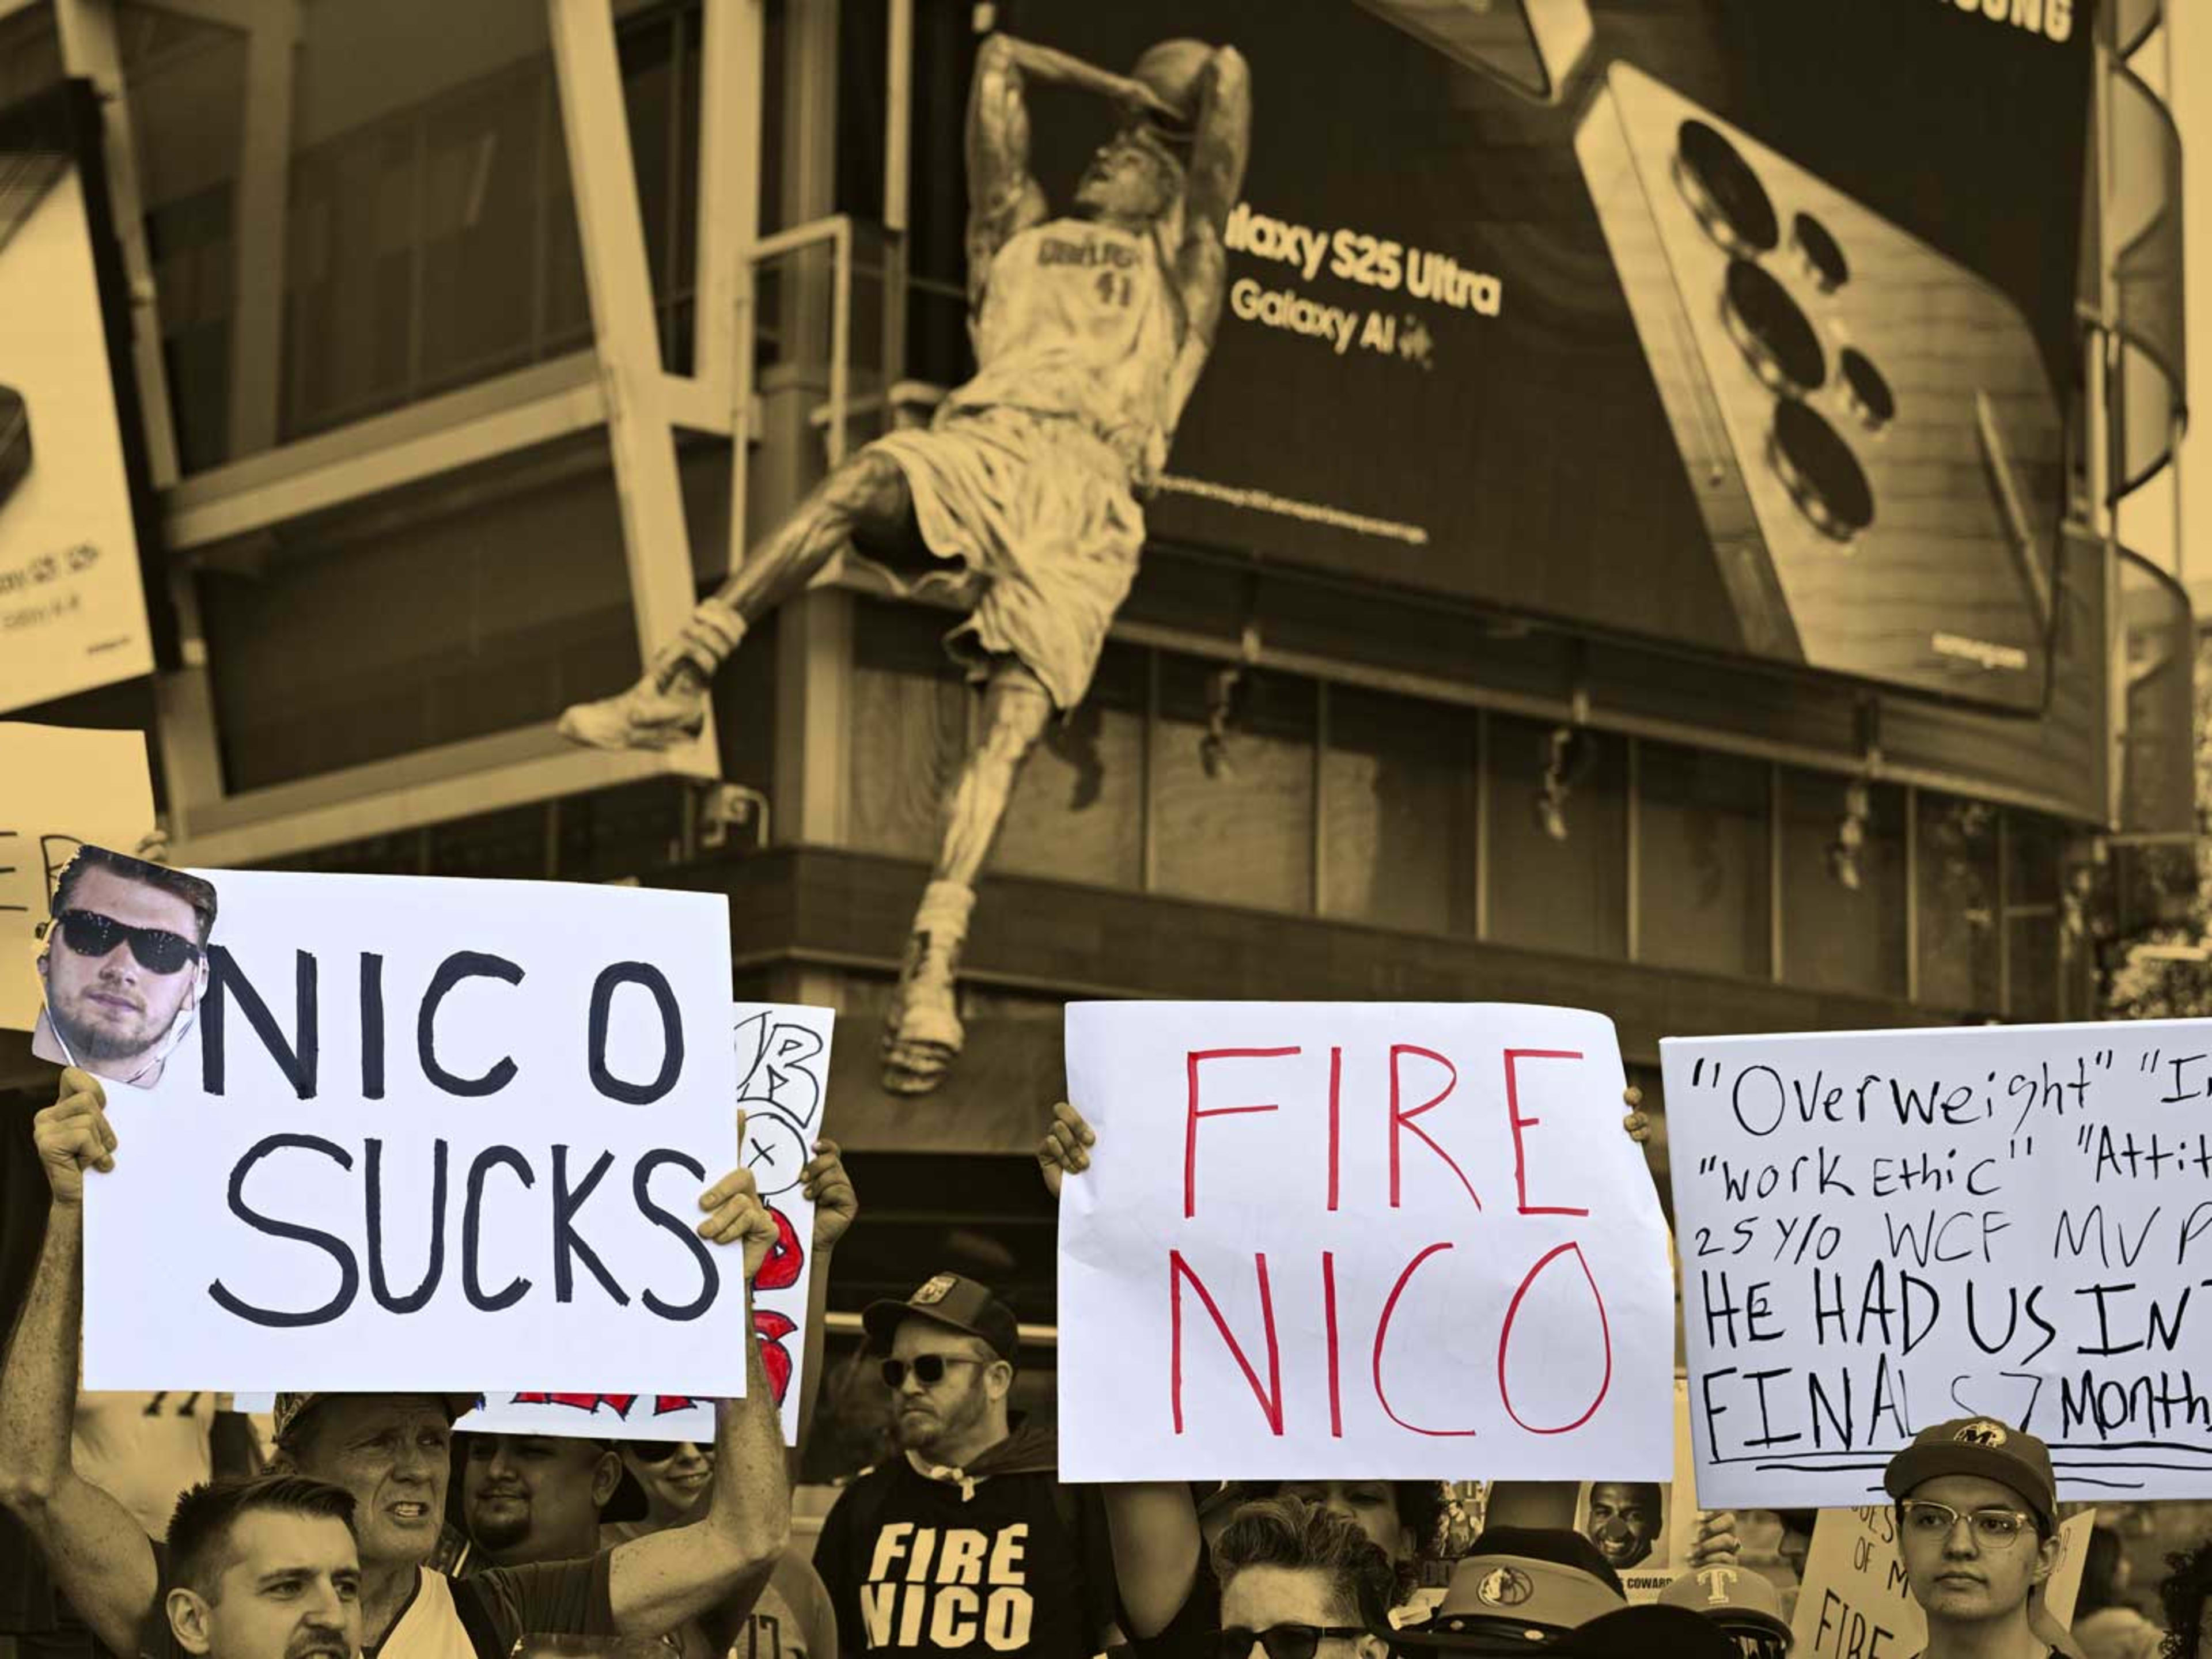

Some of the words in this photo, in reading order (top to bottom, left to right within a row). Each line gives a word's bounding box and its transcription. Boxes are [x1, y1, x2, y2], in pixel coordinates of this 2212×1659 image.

[1225, 202, 1328, 281] laxy
[1330, 228, 1402, 291] S25
[1406, 248, 1501, 317] Ultra
[1230, 278, 1358, 355] Galaxy
[199, 943, 684, 1105] NICO
[1184, 1044, 1589, 1219] FIRE
[208, 1132, 719, 1327] SUCKS
[1884, 1209, 2011, 1268] WCF
[1170, 1241, 1611, 1438] NICO
[1701, 1269, 1786, 1349] HE
[1813, 1259, 1940, 1357] HAD
[1966, 1278, 2056, 1366] US
[2074, 1282, 2191, 1356] IN
[2061, 1369, 2212, 1440] Month
[868, 1522, 1029, 1586] FIRE
[1697, 1567, 1738, 1605] T
[1854, 1536, 1875, 1574] OF
[860, 1581, 1034, 1651] NICO
